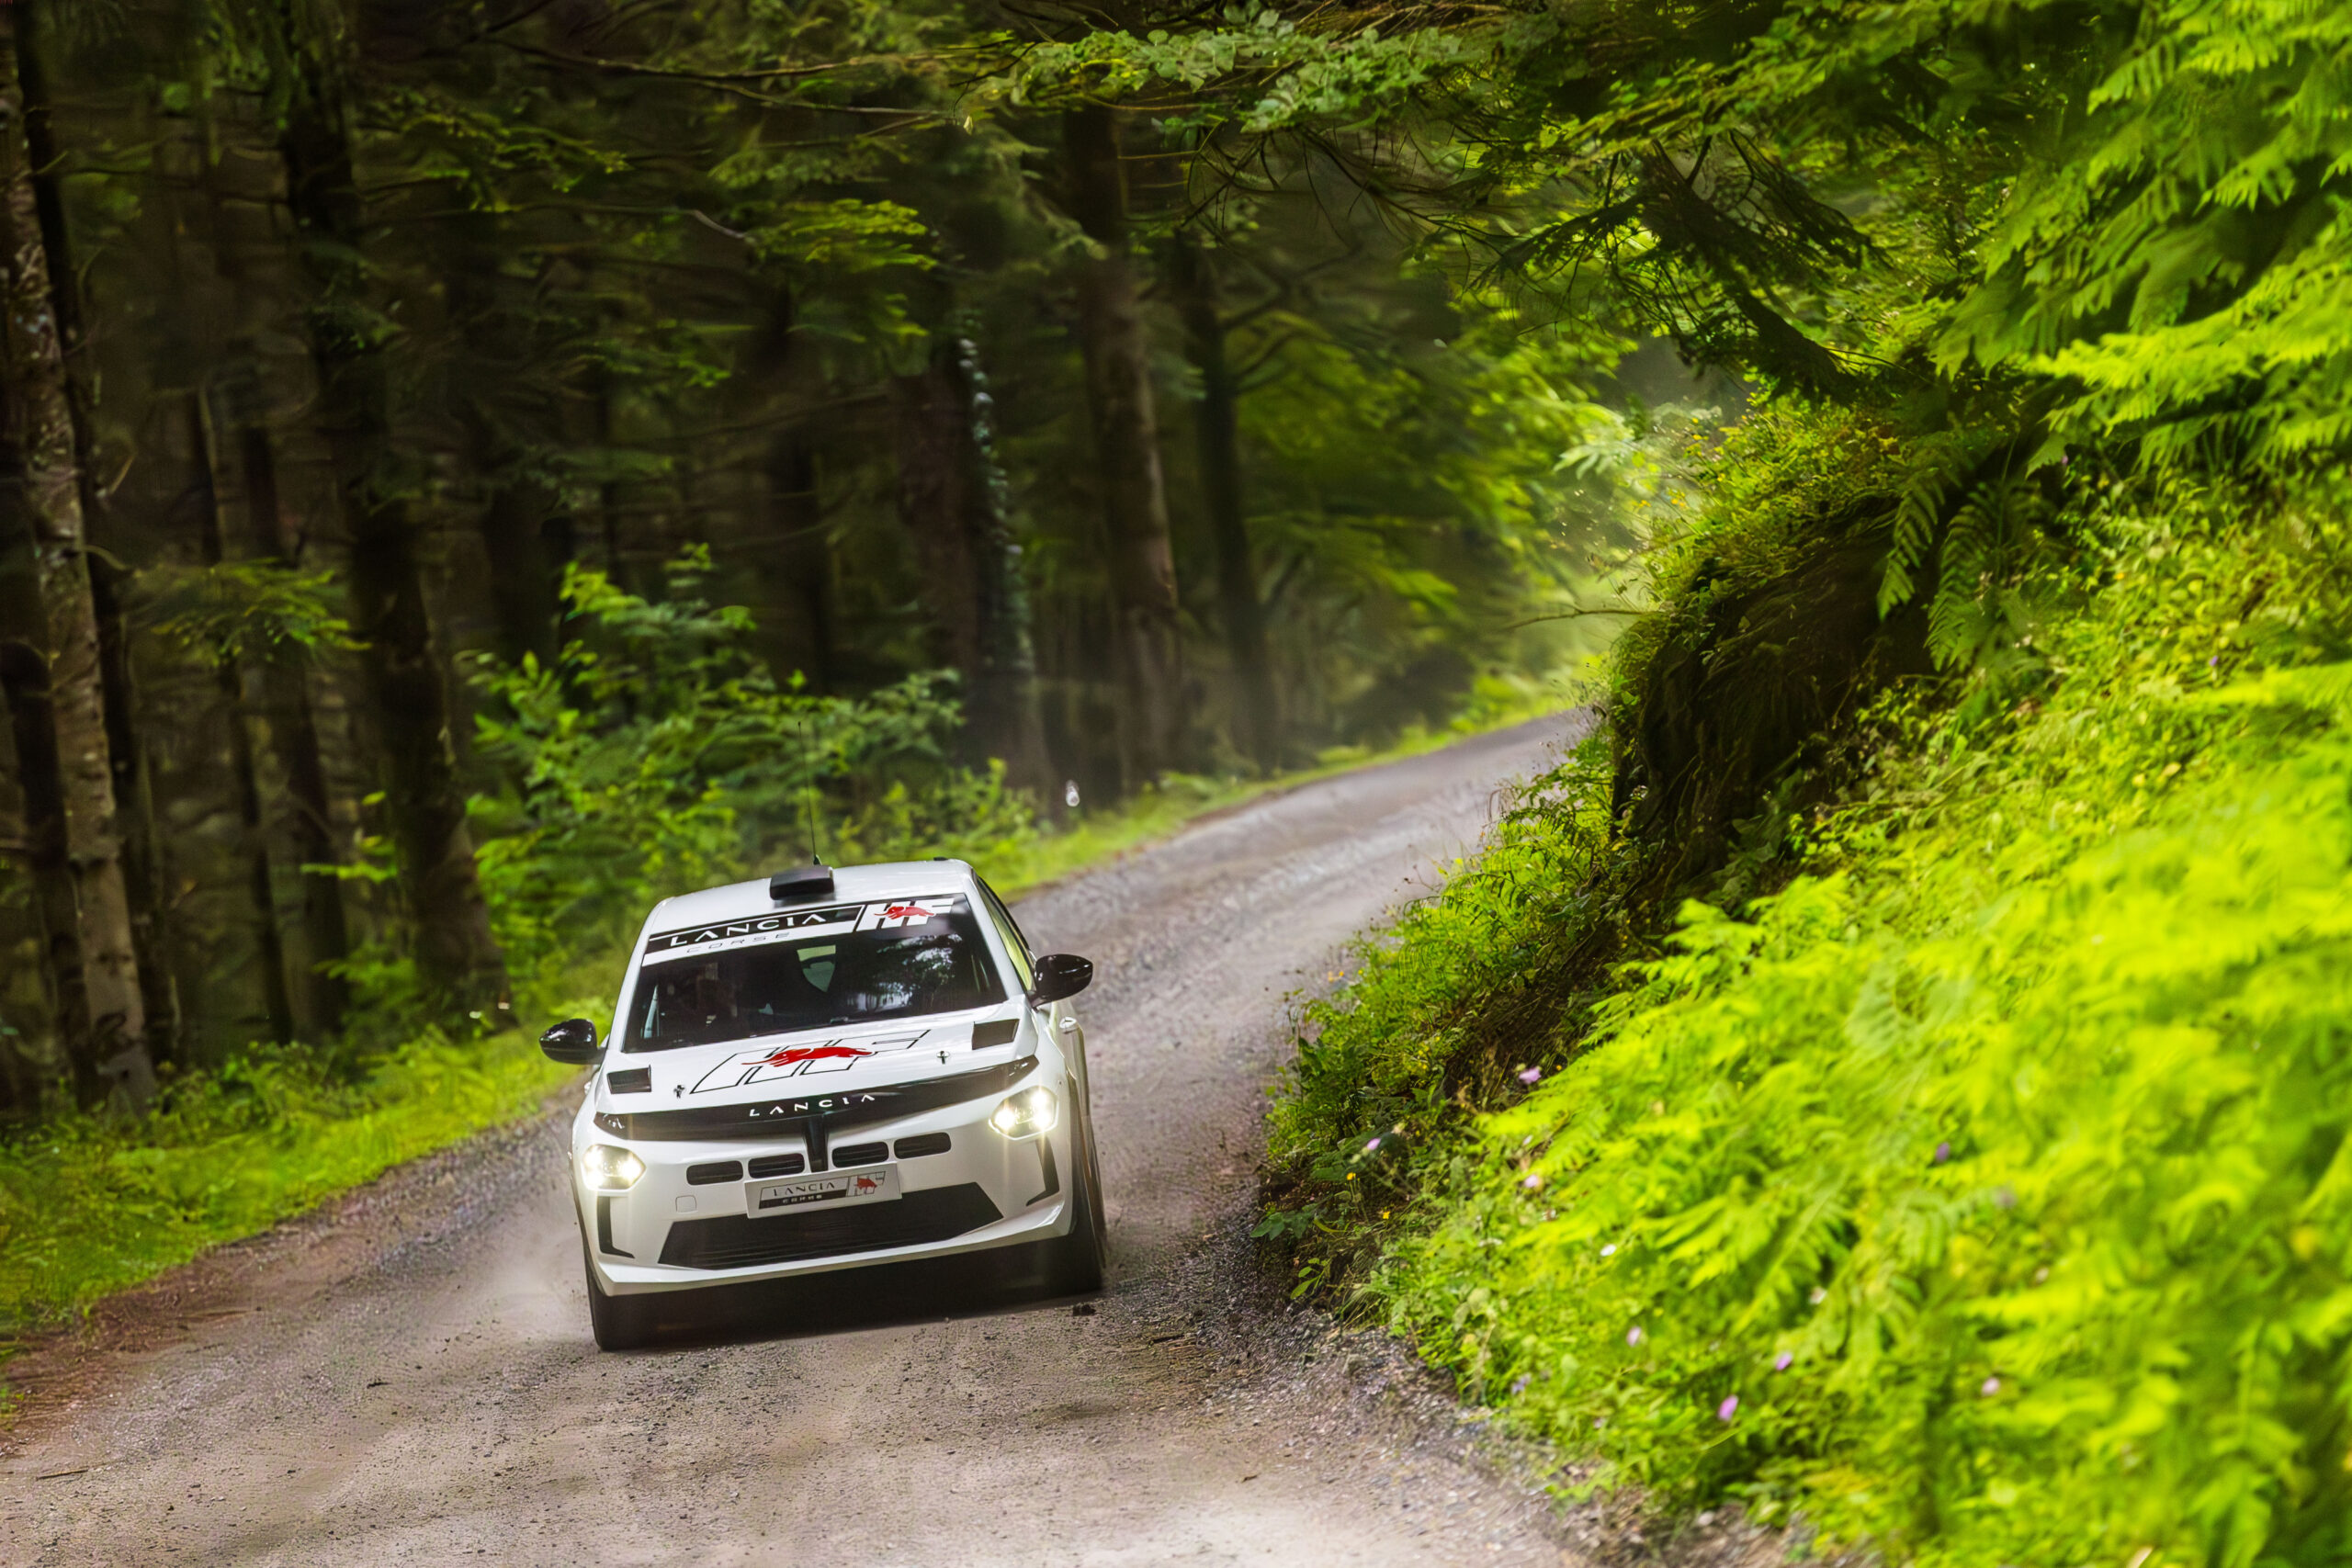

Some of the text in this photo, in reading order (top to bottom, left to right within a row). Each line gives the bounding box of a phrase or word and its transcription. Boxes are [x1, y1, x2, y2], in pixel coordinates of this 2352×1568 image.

[670, 913, 826, 947] LANCIA
[686, 931, 790, 953] CORSE
[749, 1094, 875, 1117] LANCIA
